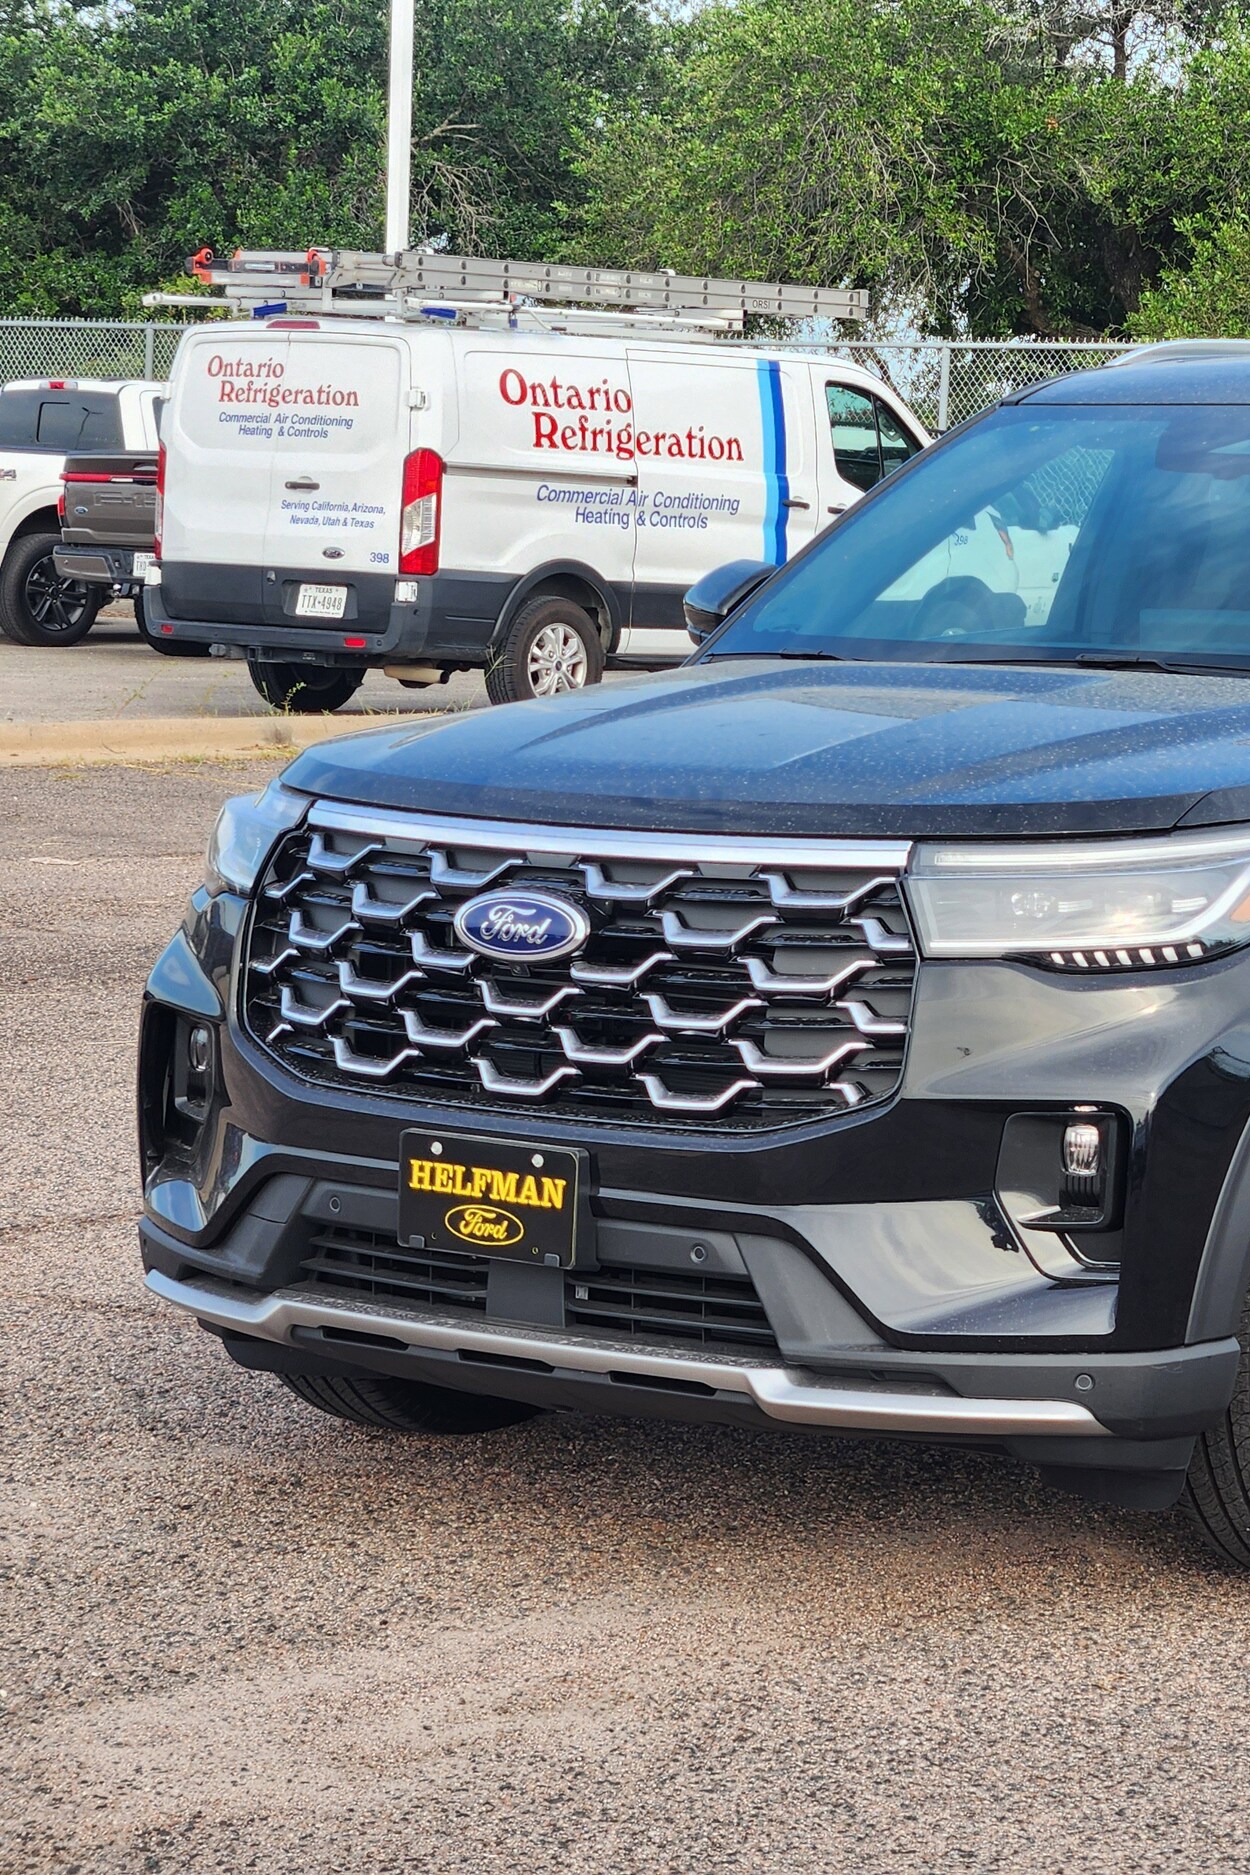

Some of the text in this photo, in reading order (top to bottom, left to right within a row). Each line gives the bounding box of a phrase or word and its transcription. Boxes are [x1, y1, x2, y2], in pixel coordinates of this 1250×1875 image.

[207, 355, 285, 379] Ontario
[218, 380, 360, 408] Refrigeration
[499, 368, 632, 414] Ontario
[219, 411, 353, 429] Commercial Air Conditioning
[238, 424, 328, 439] Heating & Controls
[531, 411, 745, 461] Refrigeration
[281, 500, 386, 515] Serving California, Arizona,
[536, 484, 740, 515] Commercial Air Conditioning
[290, 515, 375, 529] Nevada, Utah & Texas
[575, 506, 708, 529] Heating & Controls
[369, 552, 390, 564] 398
[315, 586, 333, 594] TEXAS
[480, 904, 552, 945] Ford
[408, 1159, 566, 1209] HELFMAN
[459, 1209, 508, 1240] Ford
